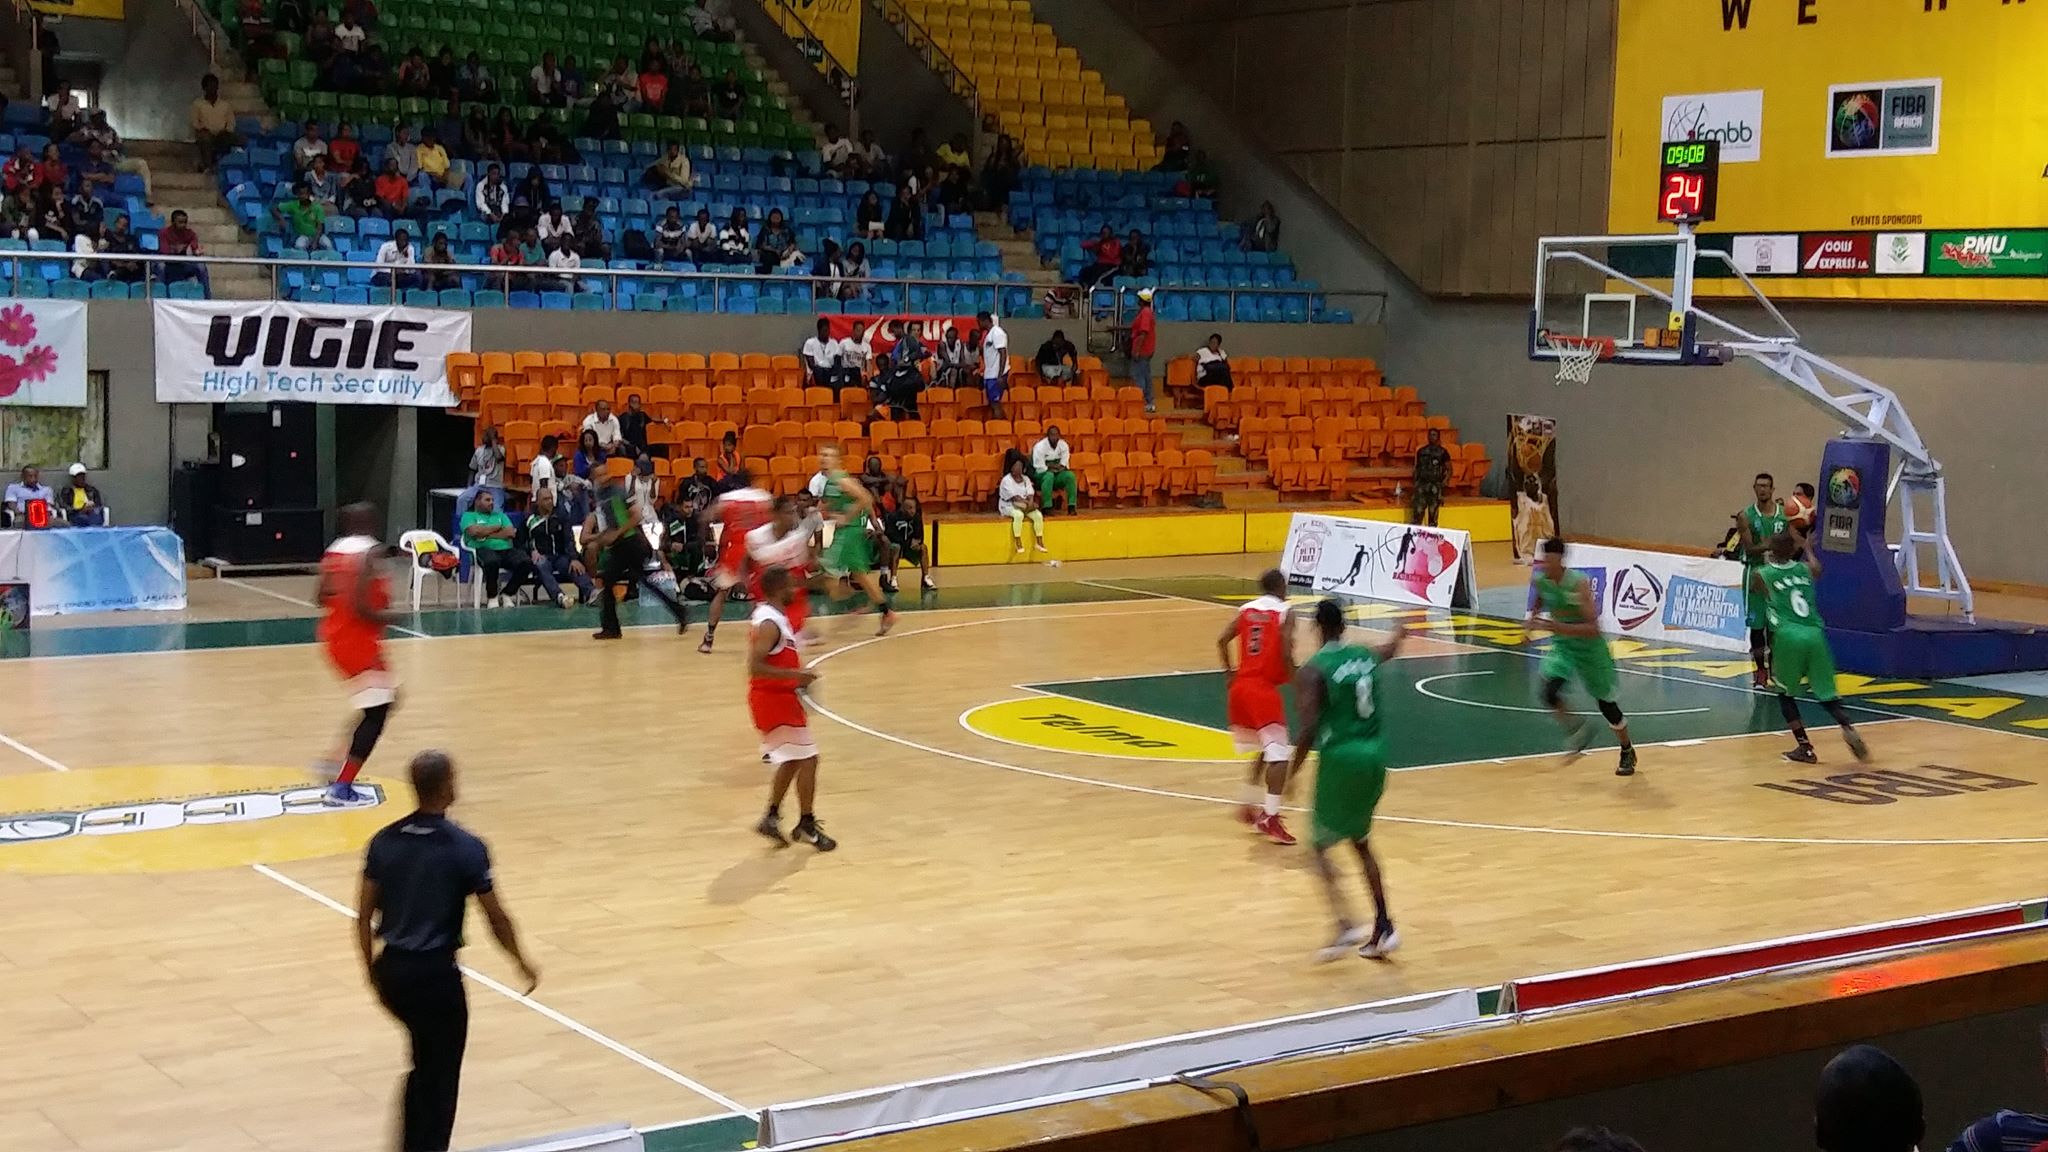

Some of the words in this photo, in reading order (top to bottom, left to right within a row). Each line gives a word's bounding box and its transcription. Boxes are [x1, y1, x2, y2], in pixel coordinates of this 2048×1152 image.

[1891, 95, 1926, 116] FIBA
[1666, 145, 1705, 165] 09:08
[1665, 175, 1702, 214] 24
[1851, 216, 1880, 226] EVENTS
[1881, 214, 1923, 225] SPONSORS
[1963, 235, 2008, 255] PMU
[1819, 257, 1856, 269] EXPRESS
[205, 315, 428, 371] VIGIE
[202, 371, 258, 396] High
[266, 371, 323, 393] Tech
[331, 373, 424, 399] Security
[1621, 582, 1651, 607] AZ
[1790, 588, 1811, 618] 6
[1018, 714, 1179, 749] Telma
[1753, 763, 2039, 805] FIBA
